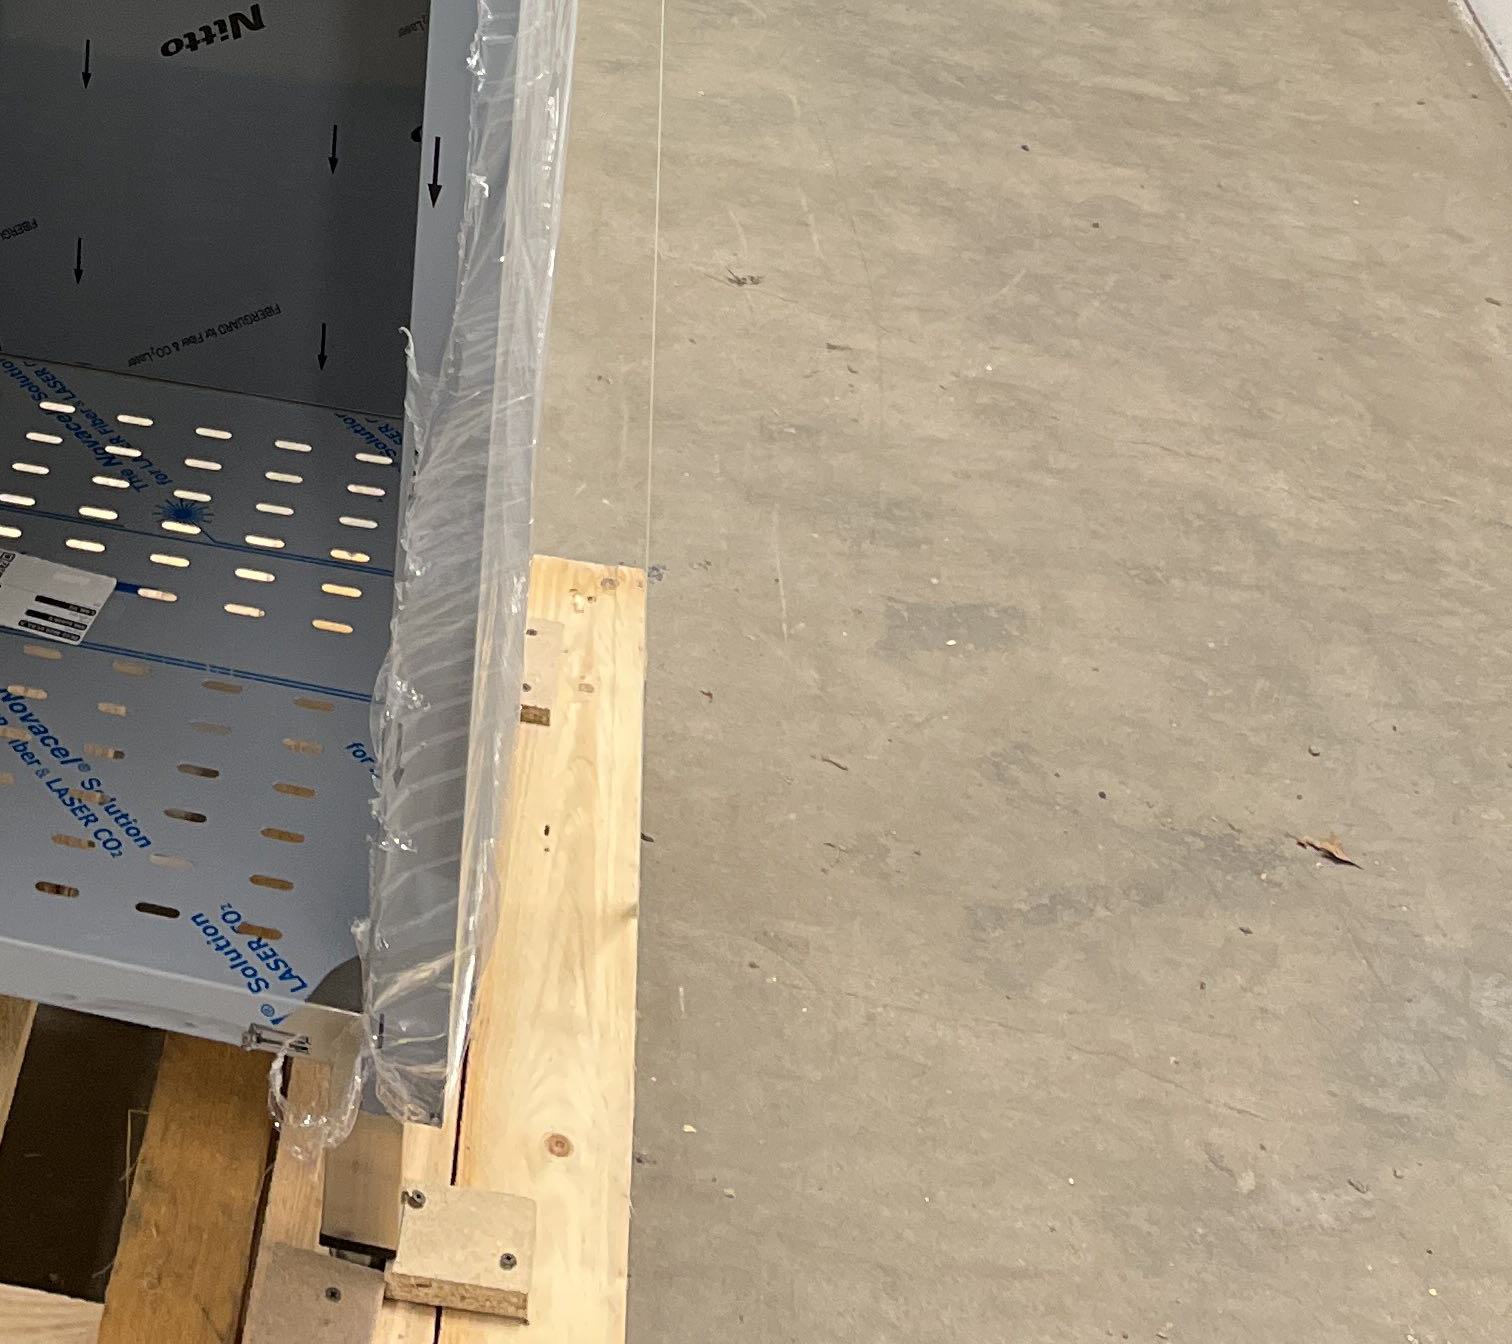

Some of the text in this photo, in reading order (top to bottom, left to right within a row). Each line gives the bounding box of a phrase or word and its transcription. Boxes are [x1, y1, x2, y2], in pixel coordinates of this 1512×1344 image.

[161, 4, 265, 56] Nitto
[34, 367, 76, 402] LASER
[80, 408, 114, 436] Fiber
[345, 742, 377, 765] for
[191, 912, 270, 994] Solution
[248, 936, 309, 993] LASER
